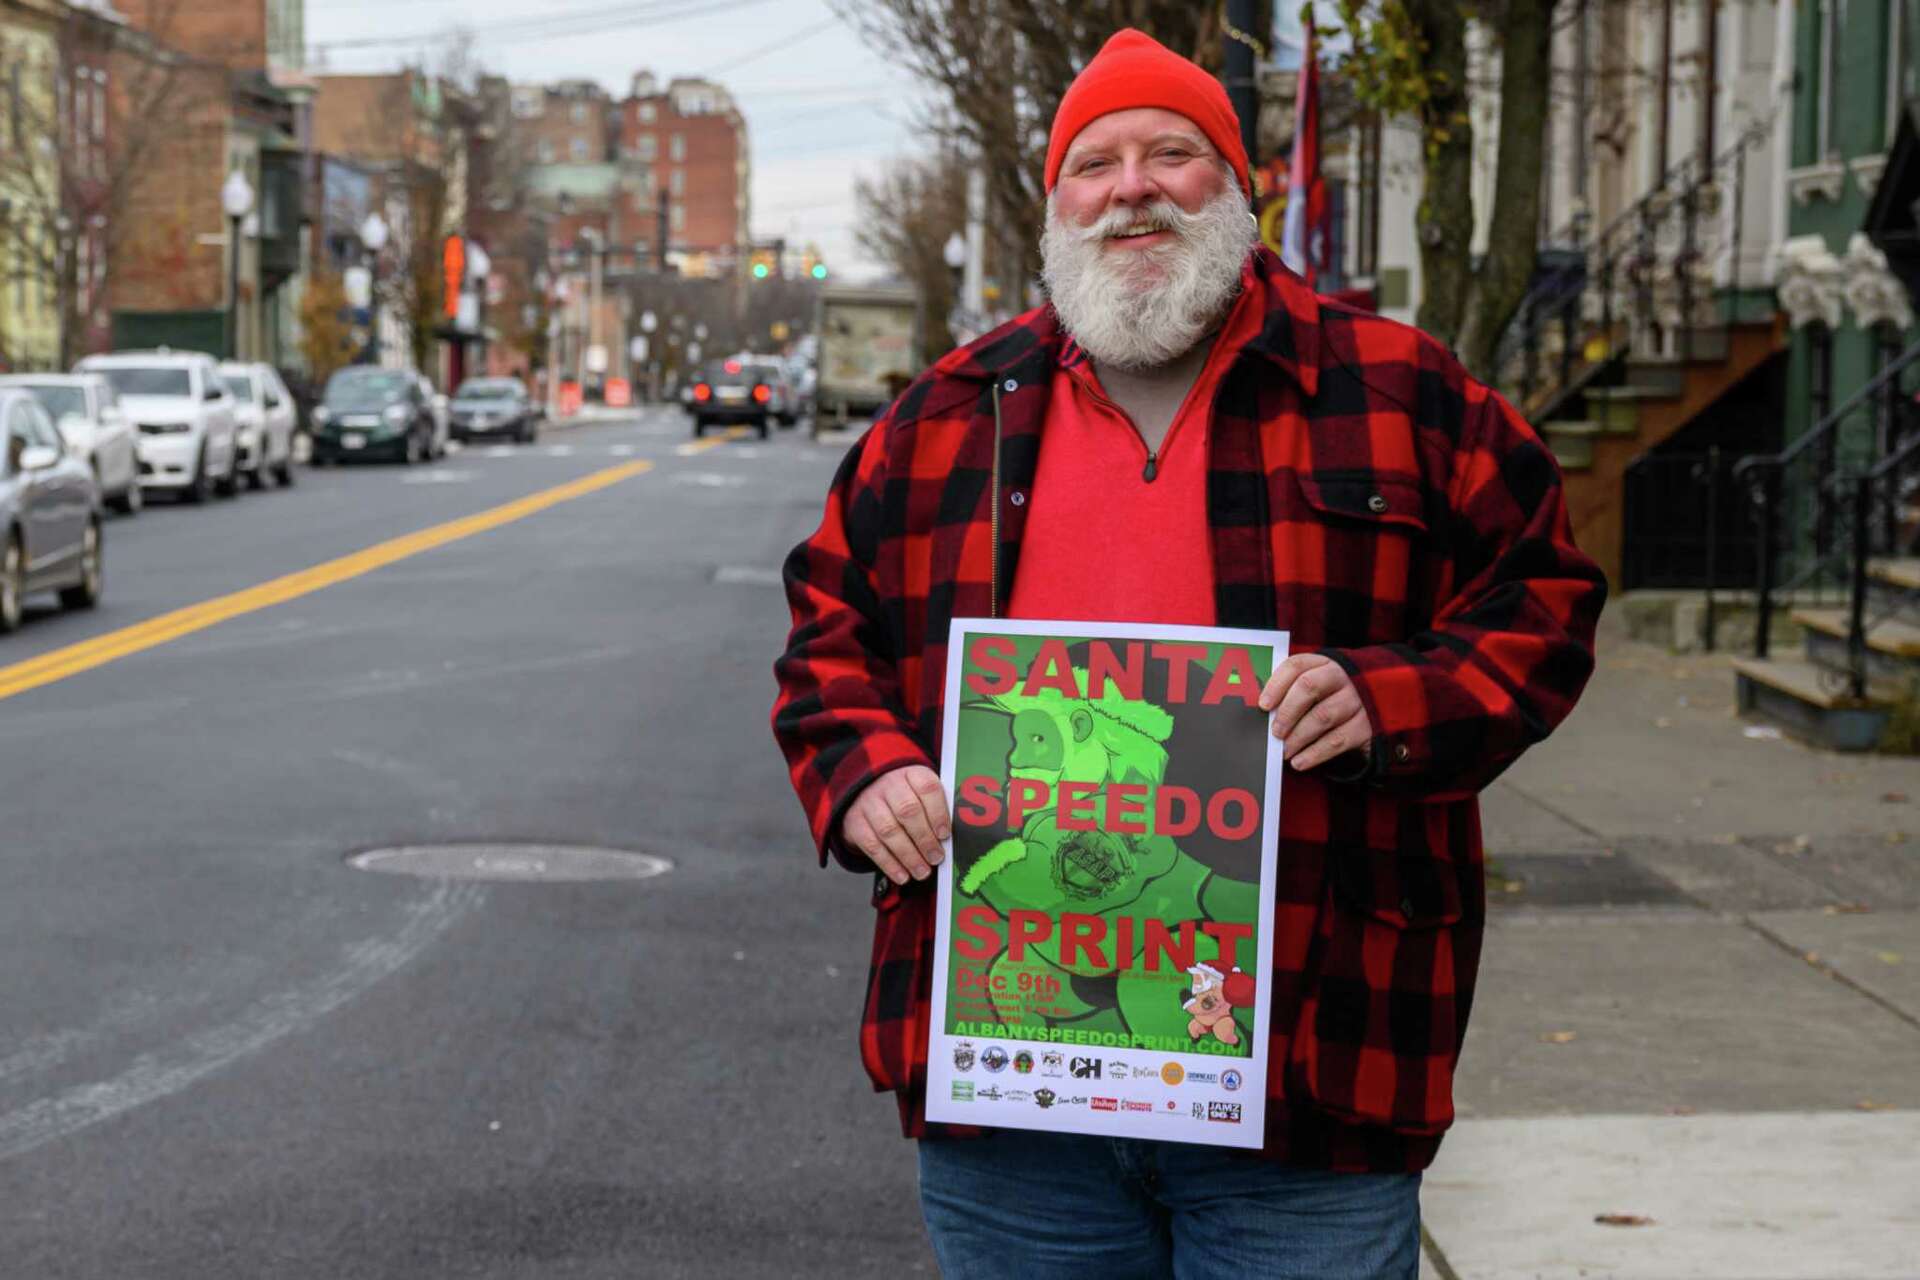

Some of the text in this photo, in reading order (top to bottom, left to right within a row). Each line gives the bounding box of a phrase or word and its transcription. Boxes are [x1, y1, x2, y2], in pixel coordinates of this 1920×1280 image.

[966, 637, 1262, 707] SANTA
[958, 775, 1261, 841] SPEEDO
[954, 906, 1253, 974] SPRINT
[955, 967, 1008, 991] Dec
[1016, 972, 1062, 994] 9th
[954, 1021, 1244, 1057] ALBANYSPEEDOSPRINT.COM
[1209, 1102, 1240, 1113] JAMZ
